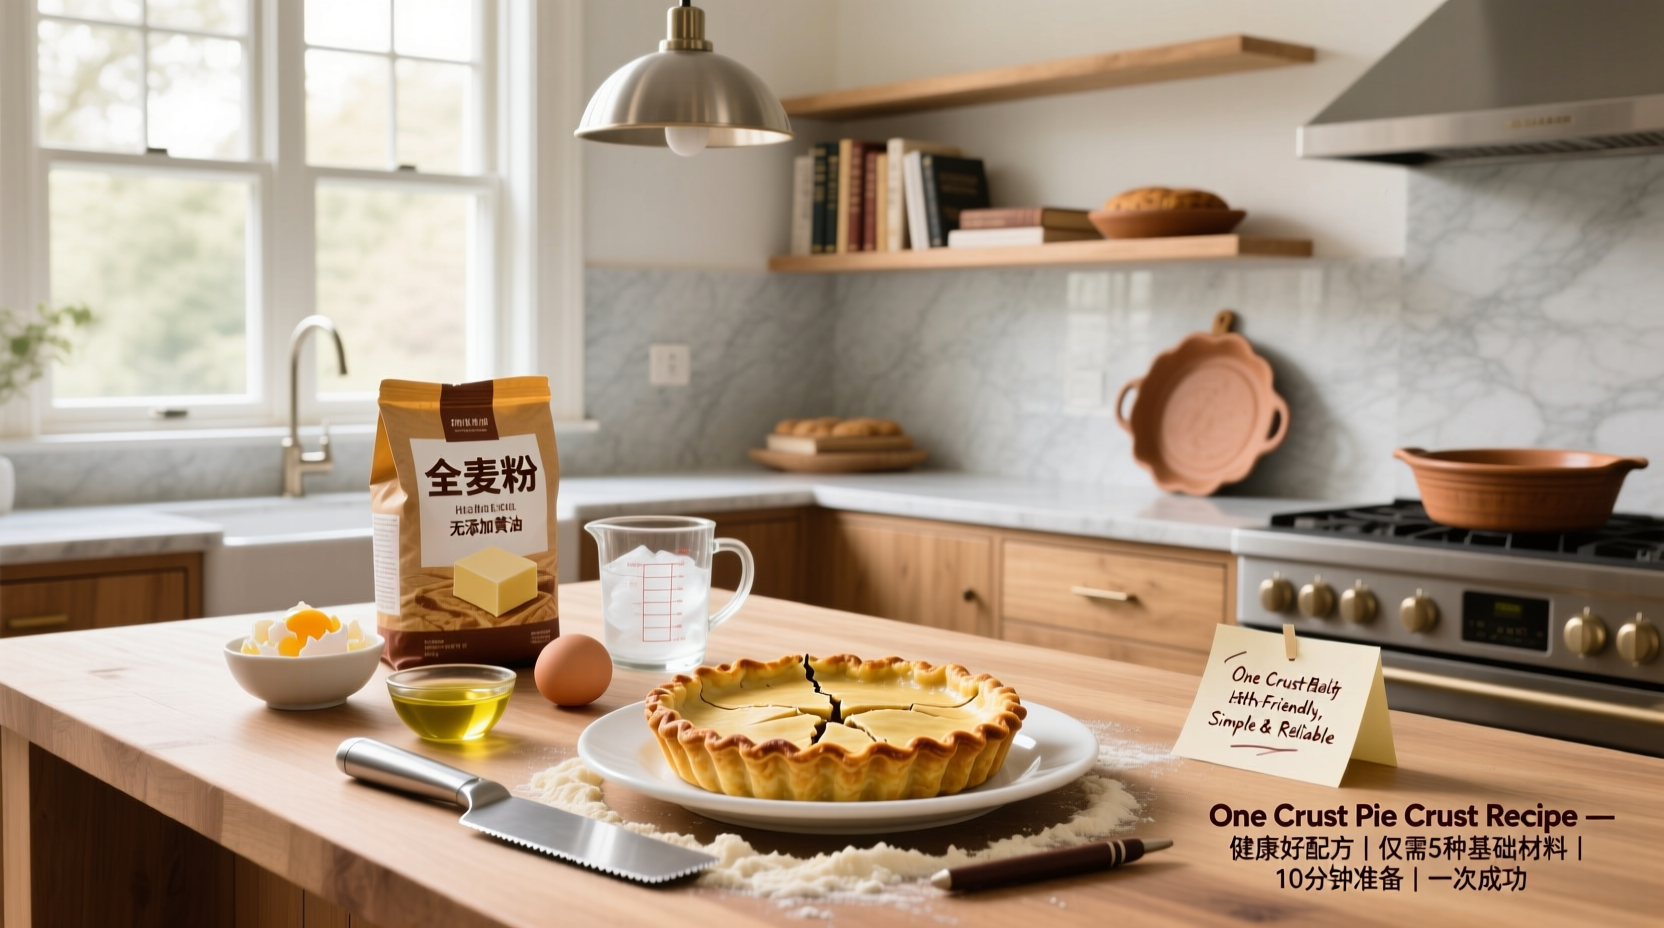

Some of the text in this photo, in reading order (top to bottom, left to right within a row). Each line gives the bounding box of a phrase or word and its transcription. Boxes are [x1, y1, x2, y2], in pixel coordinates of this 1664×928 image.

[425, 454, 537, 497] 全麦粉
[1232, 665, 1261, 685] One
[1265, 671, 1308, 692] Crust
[1208, 710, 1336, 745] Simple & Reliable
